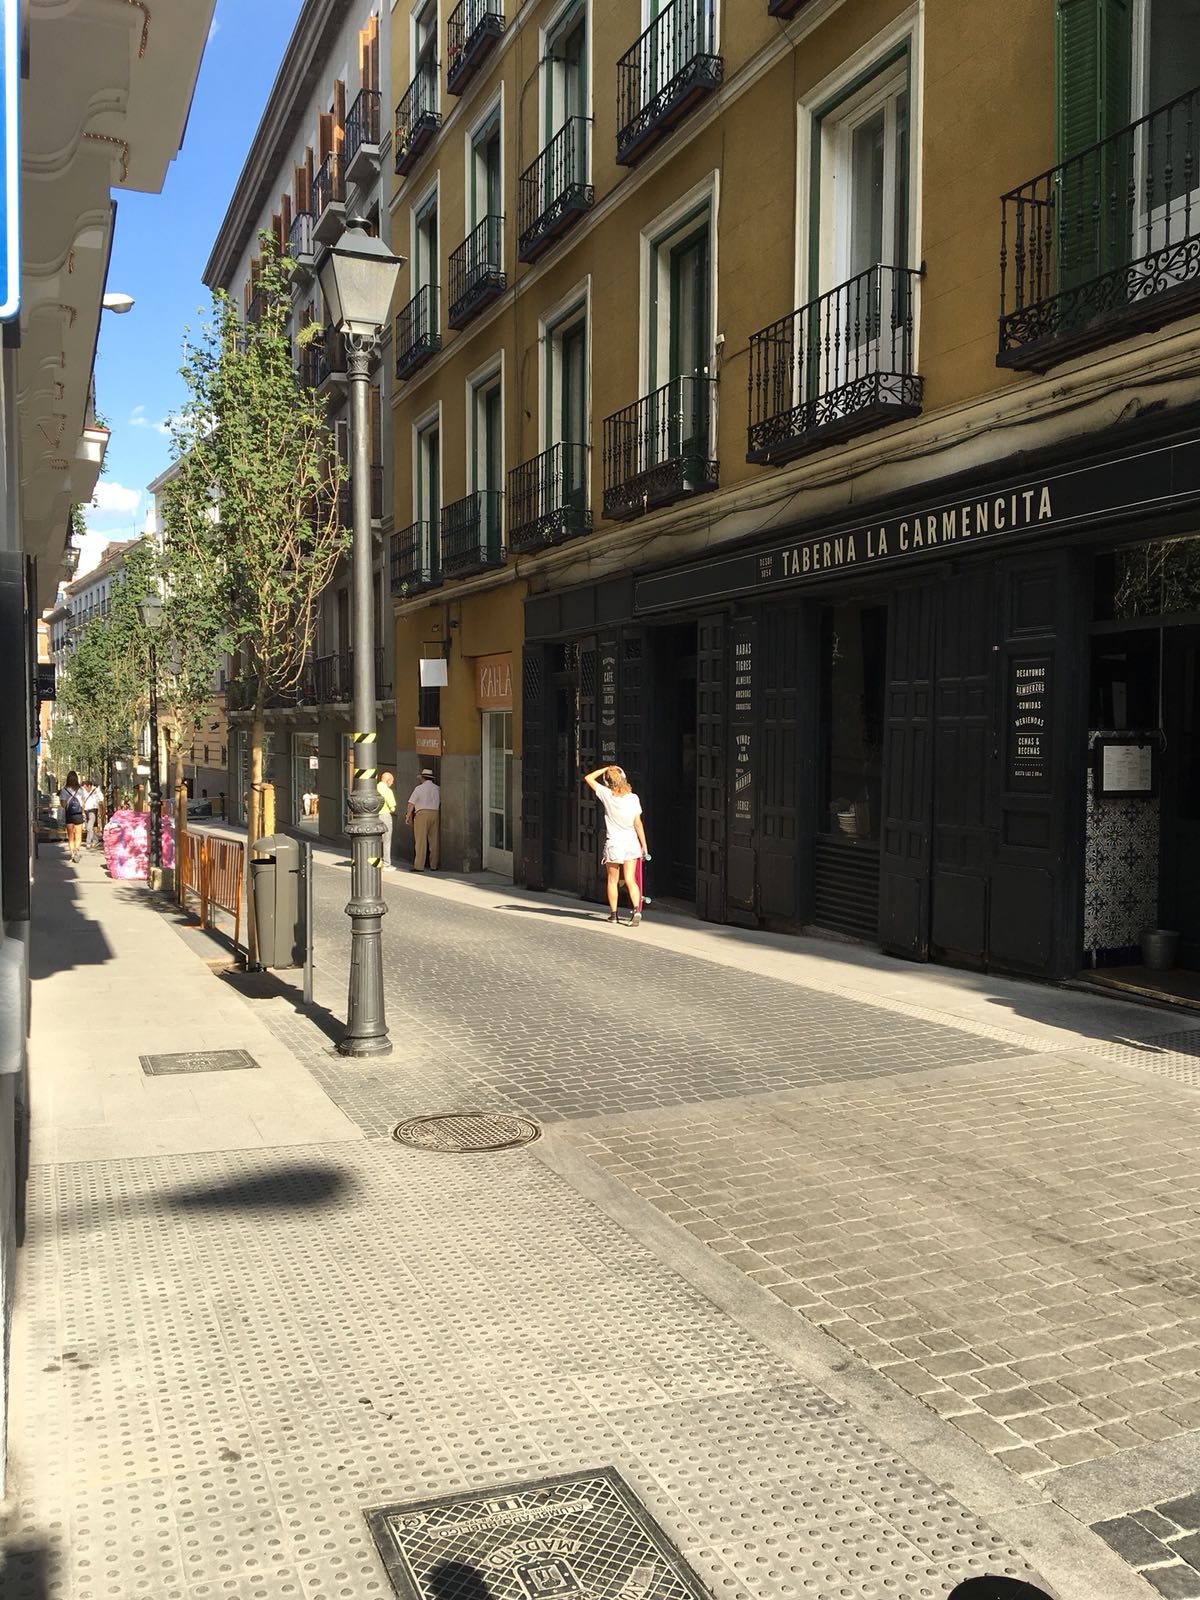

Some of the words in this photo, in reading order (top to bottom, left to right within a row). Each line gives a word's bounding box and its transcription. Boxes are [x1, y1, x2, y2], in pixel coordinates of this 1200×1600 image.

[782, 536, 856, 576] TABERNA
[867, 528, 888, 558] LA
[900, 487, 1052, 550] CARMENCITA
[1016, 668, 1045, 678] DESAYUNOS
[1016, 683, 1045, 695] ALMUERZOS
[1015, 716, 1045, 727] MERIENDAS
[503, 1504, 584, 1526] ALUMBRADO
[439, 1520, 498, 1537] PUBLICO
[489, 1538, 575, 1565] MADRID
